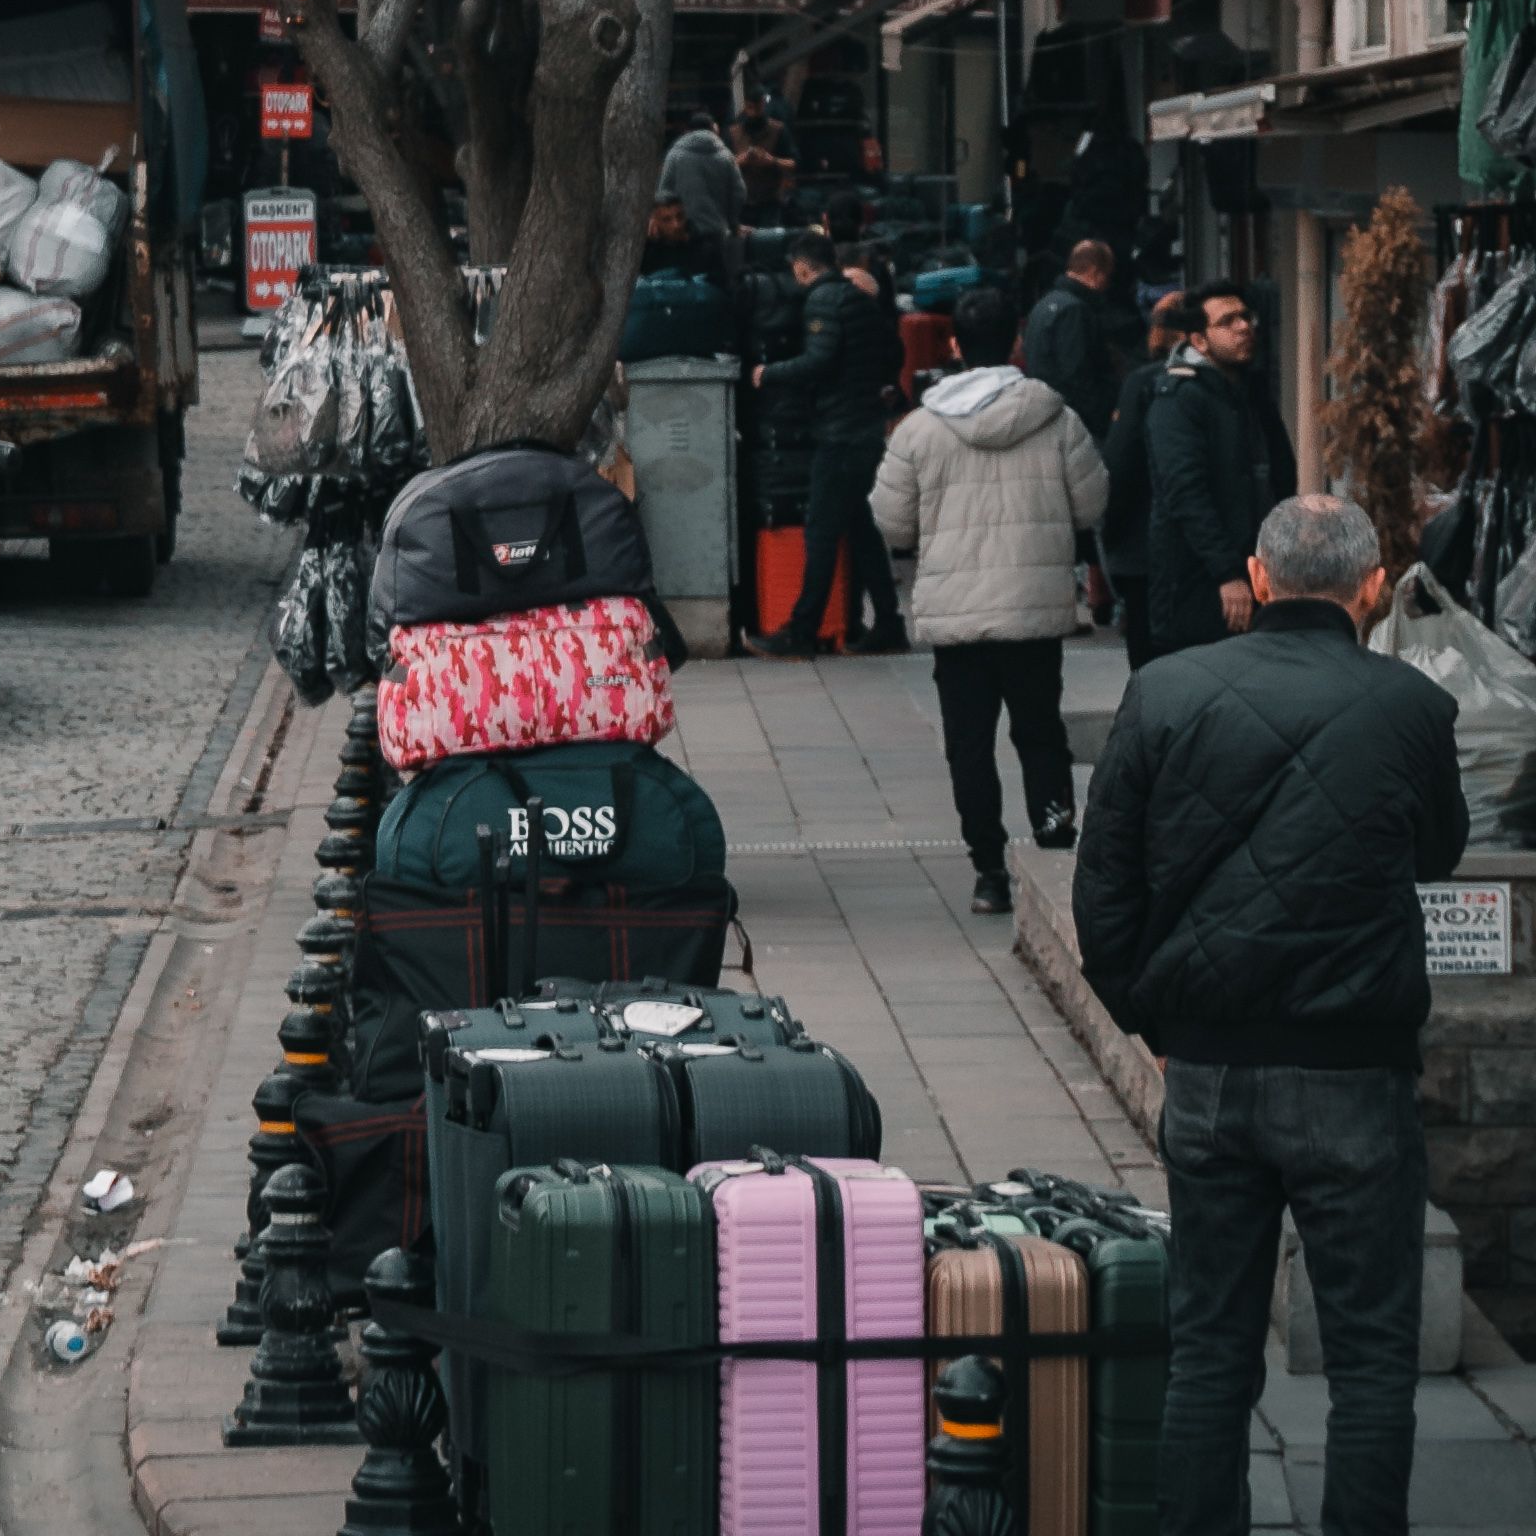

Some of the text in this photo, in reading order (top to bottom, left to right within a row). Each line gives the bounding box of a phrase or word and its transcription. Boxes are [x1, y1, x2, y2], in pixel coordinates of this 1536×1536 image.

[265, 91, 309, 113] OTOPARK
[251, 203, 310, 219] BAŞKENT
[250, 230, 312, 272] OTOPARK
[507, 806, 617, 841] BOSS
